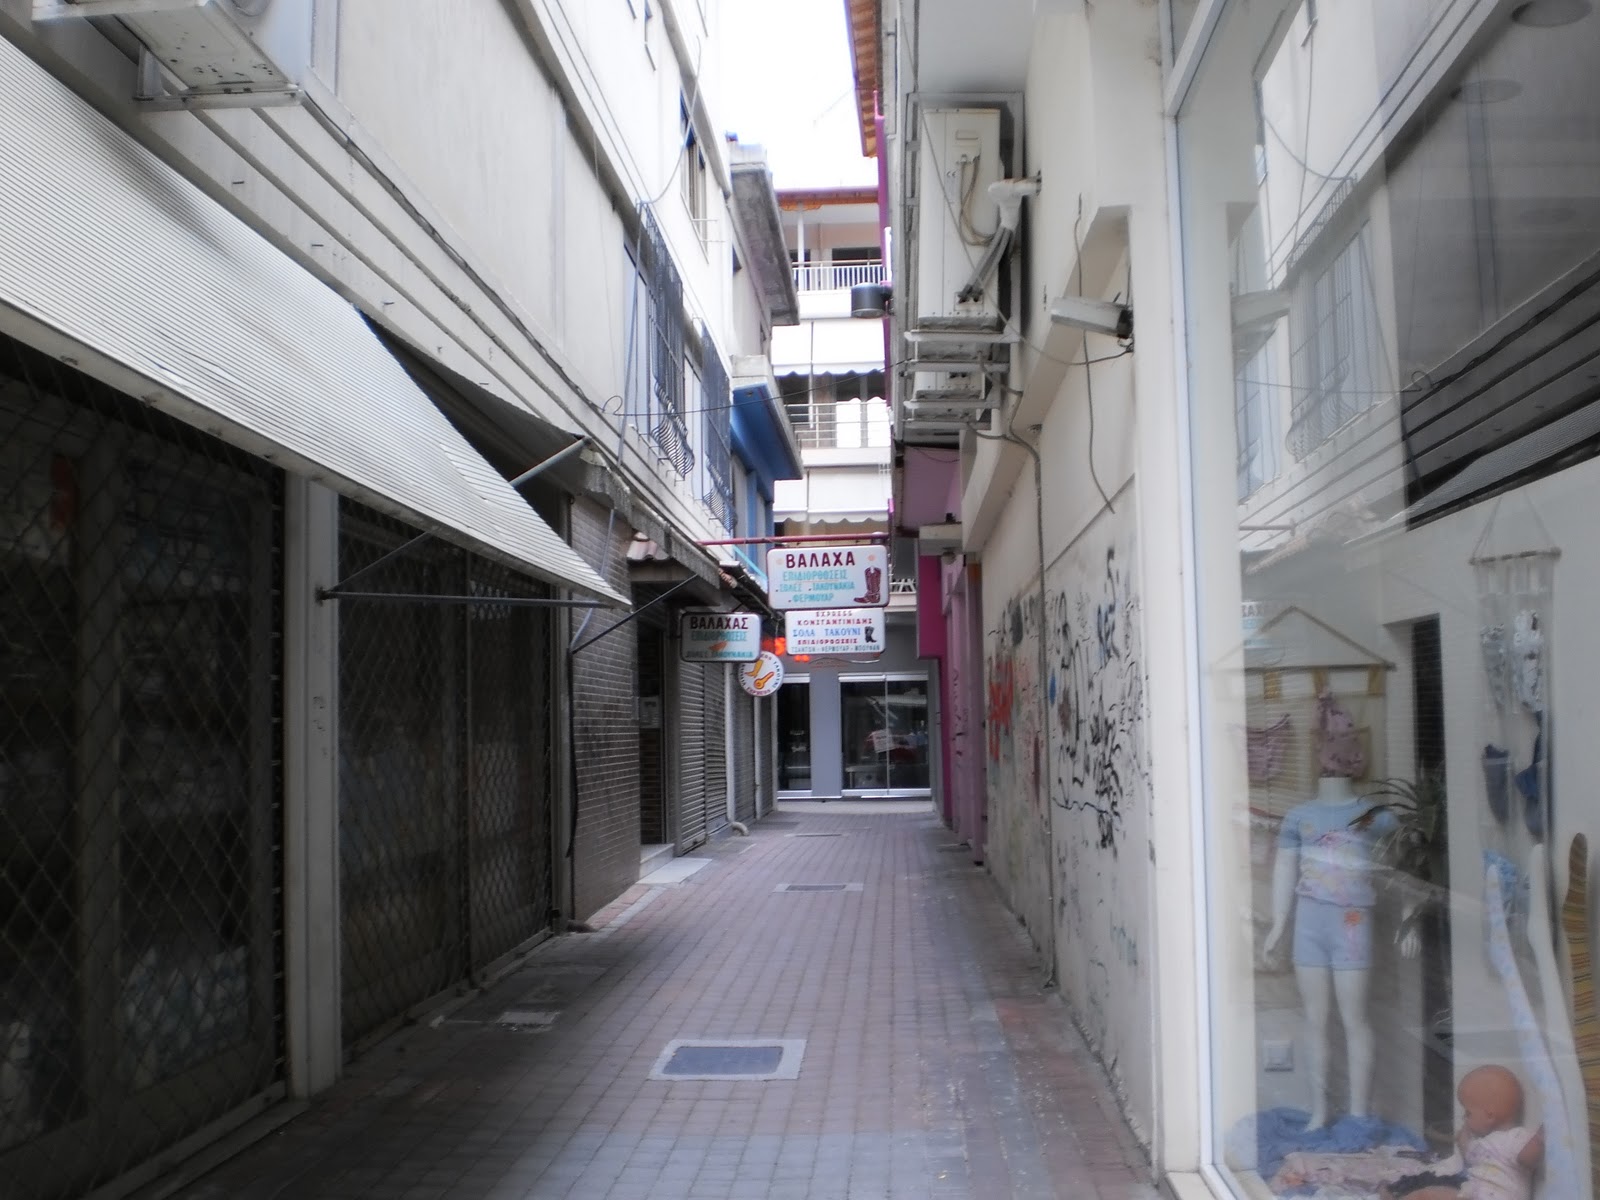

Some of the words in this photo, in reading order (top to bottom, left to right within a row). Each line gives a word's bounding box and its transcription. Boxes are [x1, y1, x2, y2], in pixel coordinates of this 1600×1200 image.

[786, 551, 855, 569] ΒΑΛΑΧΑ
[690, 616, 748, 629] ΒΑΛΑΧΑΣ
[792, 629, 815, 637] ΣΟΛΑ
[824, 628, 861, 637] ΤΑΚΟΥΝΙ
